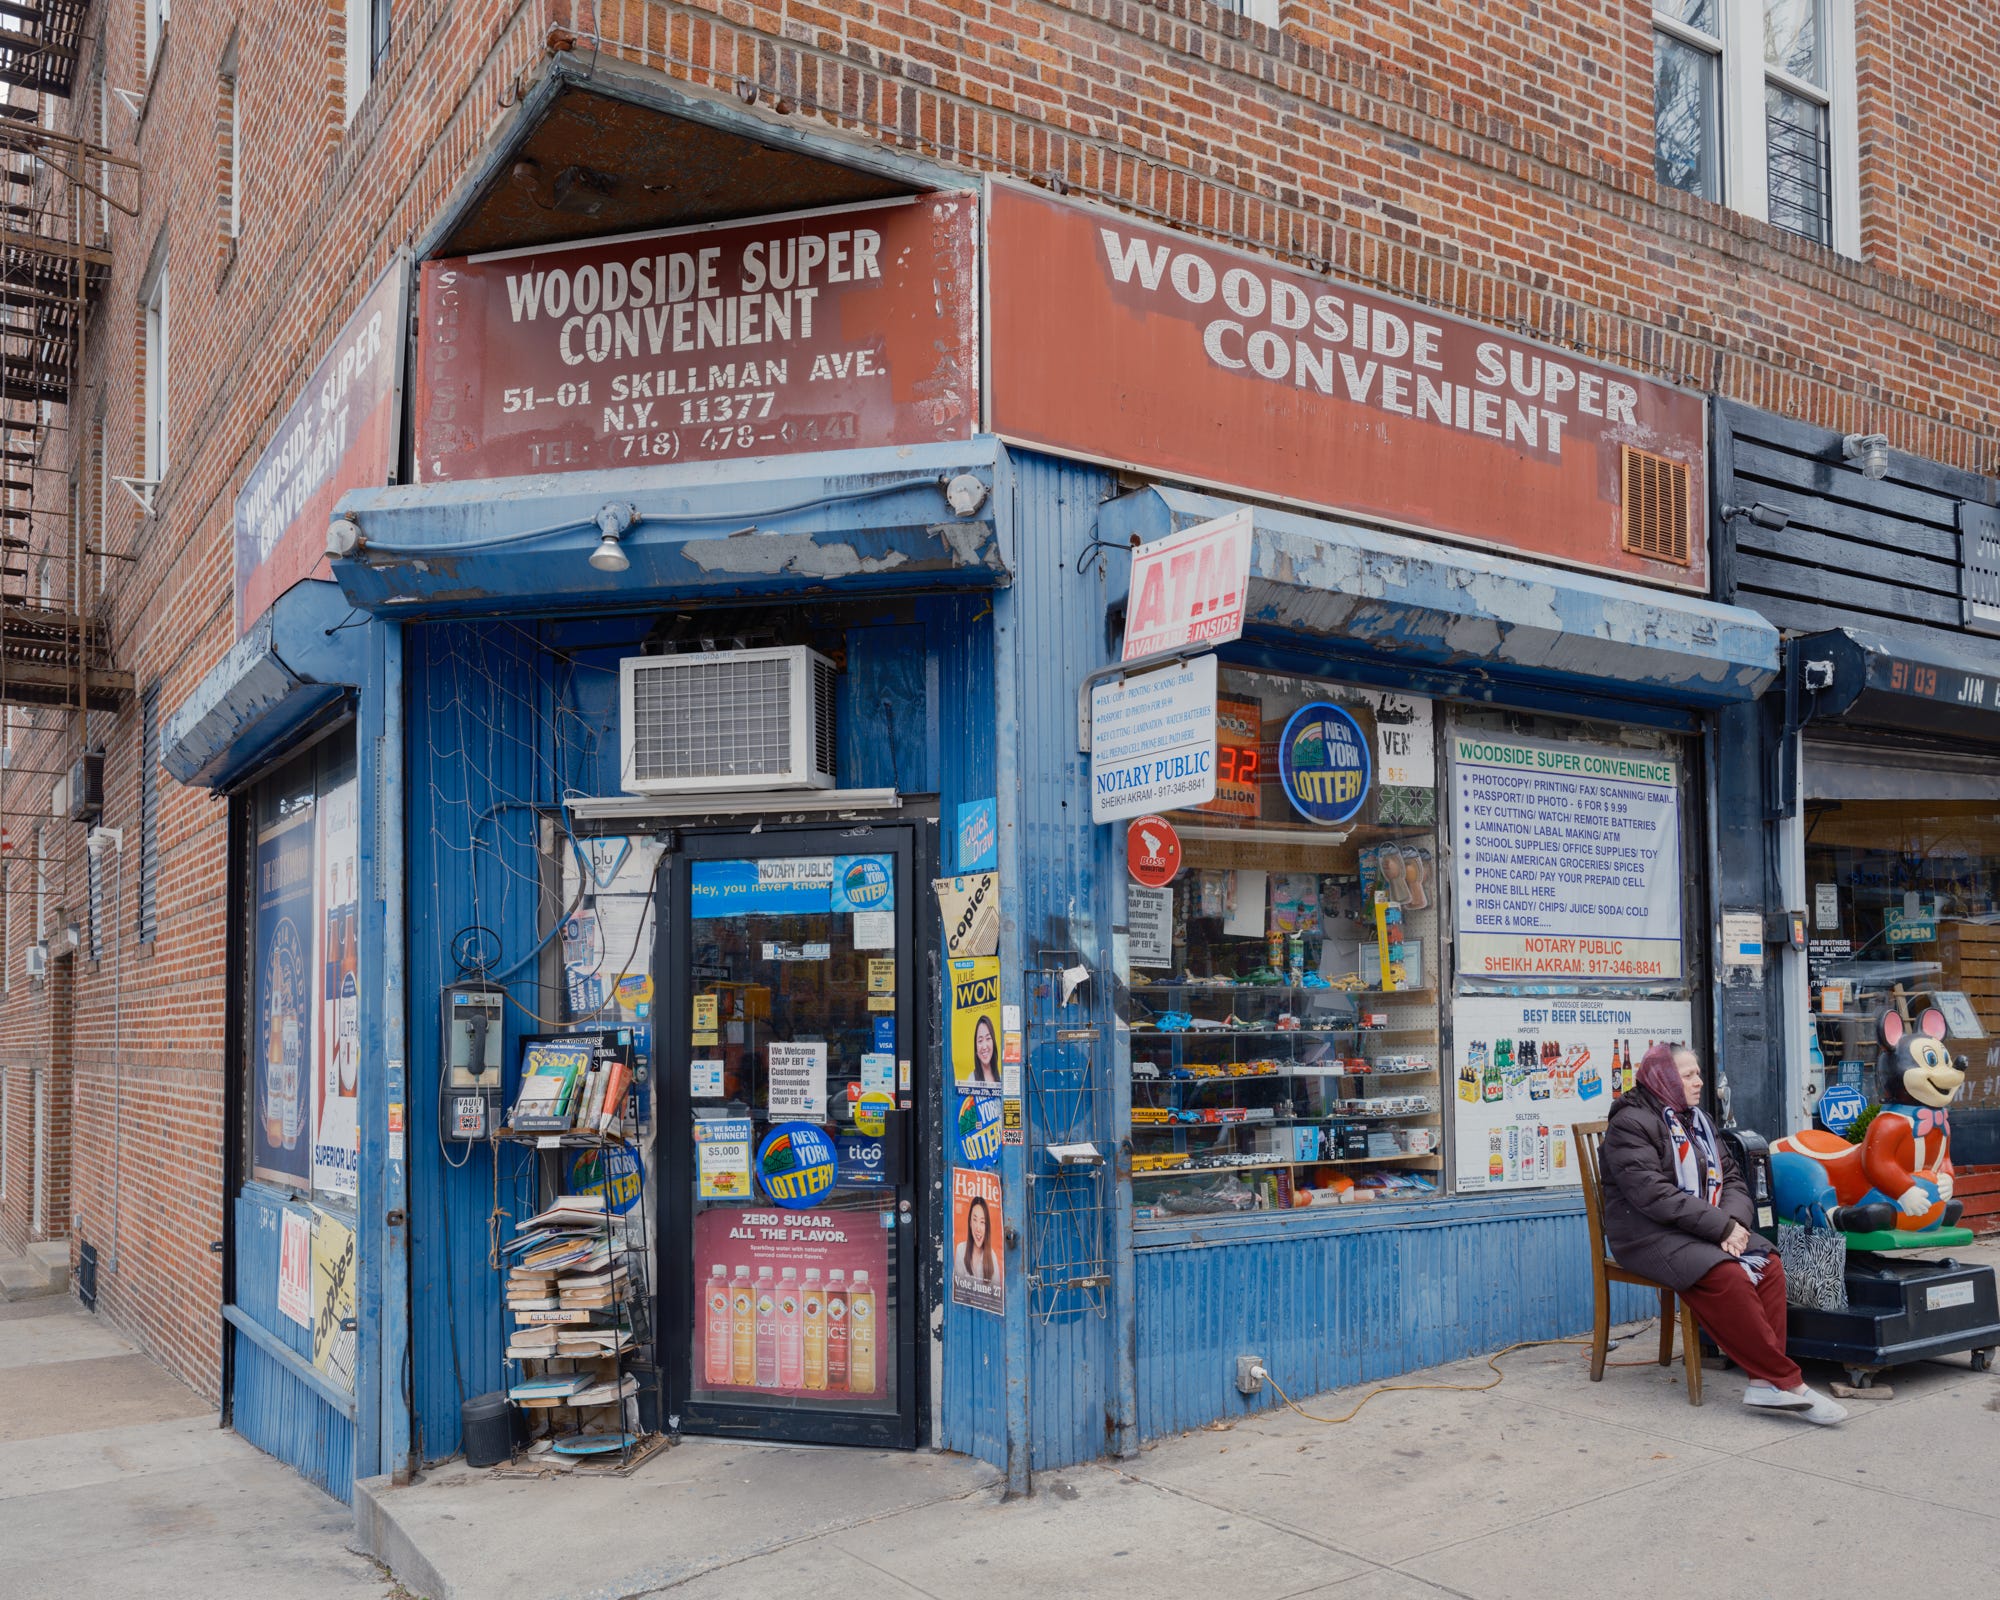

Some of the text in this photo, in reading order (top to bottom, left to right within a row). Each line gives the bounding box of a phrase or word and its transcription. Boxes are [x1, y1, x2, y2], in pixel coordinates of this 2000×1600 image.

[506, 229, 882, 323] WOODSIDE SUPER
[559, 288, 818, 367] CONVENIENT
[1100, 228, 1443, 372] WOODSIDE
[1476, 343, 1638, 426] SUPER
[503, 350, 887, 414] 51-01 SKILLMAN AVE.
[1203, 319, 1568, 454] CONVENIENT
[245, 310, 382, 534] WOODSIDE SUPER
[603, 392, 776, 432] N.Y. 11377
[260, 404, 349, 566] CONVENIENT
[1132, 535, 1237, 634] ATM
[1195, 614, 1238, 641] INSIDE
[1890, 661, 1909, 690] 51
[1914, 668, 1937, 696] 03
[1957, 677, 1985, 704] JIN
[1324, 721, 1352, 742] NEW
[1327, 741, 1360, 767] YORK
[1460, 743, 1671, 782] WOODSIDE SUPER CONVENIENCE
[1096, 750, 1210, 794] NOTARY PUBLIC
[1219, 747, 1257, 785] 32
[1101, 778, 1206, 809] SHEIKH AKRAM 917-346-8841
[1292, 770, 1363, 805] LOTTERY
[1472, 774, 1674, 804] PHOTOCOPY/ PRINTING/ FAX/ SCANNING/ EMAIL
[1473, 790, 1525, 805] PASSPORT/
[1526, 795, 1535, 805] ID
[1537, 795, 1569, 808] PHOTO
[1577, 800, 1583, 809] 6
[1584, 801, 1603, 811] FOR
[1610, 803, 1628, 814] 9.99
[965, 810, 990, 844] Quick
[1474, 806, 1657, 831] KEY CUTTING/ WATCH/ REMOTE BATTERIES
[1474, 821, 1621, 842] LAMINATION/ LABAL MAKING/ ATM
[972, 828, 995, 863] Draw
[1475, 836, 1658, 860] SCHOOL SUPPLIES/ OFFICE SUPPLIES/ TOY
[759, 862, 833, 879] NOTARY PUBLIC
[863, 863, 881, 873] NEW
[1140, 855, 1166, 867] BOSS
[1476, 852, 1645, 873] INDIAN/ AMERICAN GROCERIES/ SPICES
[865, 872, 886, 884] YORK
[1475, 868, 1645, 888] PHONE CARD/ PAY YOUR PREPAID CELL
[691, 883, 790, 897] Hey, you never
[847, 883, 888, 904] LOTTERY
[1136, 889, 1164, 900] Welcome
[1475, 884, 1556, 897] PHONE BILL HERE
[949, 874, 992, 951] copies
[1142, 900, 1154, 909] EBT
[1475, 899, 1649, 917] IRISH CANDY/ CHIPS/ JUICE/ SODA/ COLD
[1475, 914, 1511, 926] BEER &
[1890, 927, 1931, 941] OPEN
[1141, 940, 1153, 949] EBT
[1525, 938, 1623, 954] NOTARY PUBLIC
[1484, 956, 1662, 975] SHEIKH AKRAM: 917-346-8841
[956, 970, 975, 985] JULIE
[957, 977, 998, 1008] WON
[1552, 1001, 1604, 1009] WOODSIDE GROCERY
[1523, 1009, 1632, 1023] BEST BEER SELECTION
[1517, 1027, 1540, 1035] IMPORTS
[771, 1046, 816, 1055] We Welcome
[771, 1057, 805, 1066] SNAP EBT
[771, 1067, 810, 1076] Customers
[772, 1087, 808, 1096] Clientes de
[772, 1097, 803, 1105] SNAP EBT
[1515, 1113, 1541, 1121] SELTZERS
[1828, 1100, 1861, 1121] ADT
[713, 1132, 748, 1141] WINNER!
[791, 1130, 821, 1146] NEW
[315, 1143, 345, 1170] SUPERIOR
[708, 1146, 740, 1157] $5,000
[795, 1144, 831, 1167] YORK
[765, 1163, 835, 1200] LOTTERY
[954, 1172, 1000, 1203] Hailie
[742, 1214, 835, 1228] ZERO SUGAR.
[729, 1227, 849, 1243] ALL THE FLAVOR.
[313, 1233, 355, 1359] copies
[954, 1276, 1002, 1297] Vote June 27
[710, 1321, 729, 1334] ICE
[733, 1322, 752, 1335] ICE
[756, 1324, 776, 1336] ICE
[779, 1325, 799, 1337] ICE
[803, 1326, 823, 1338] ICE
[827, 1327, 847, 1340] ICE
[851, 1328, 872, 1341] ICE
